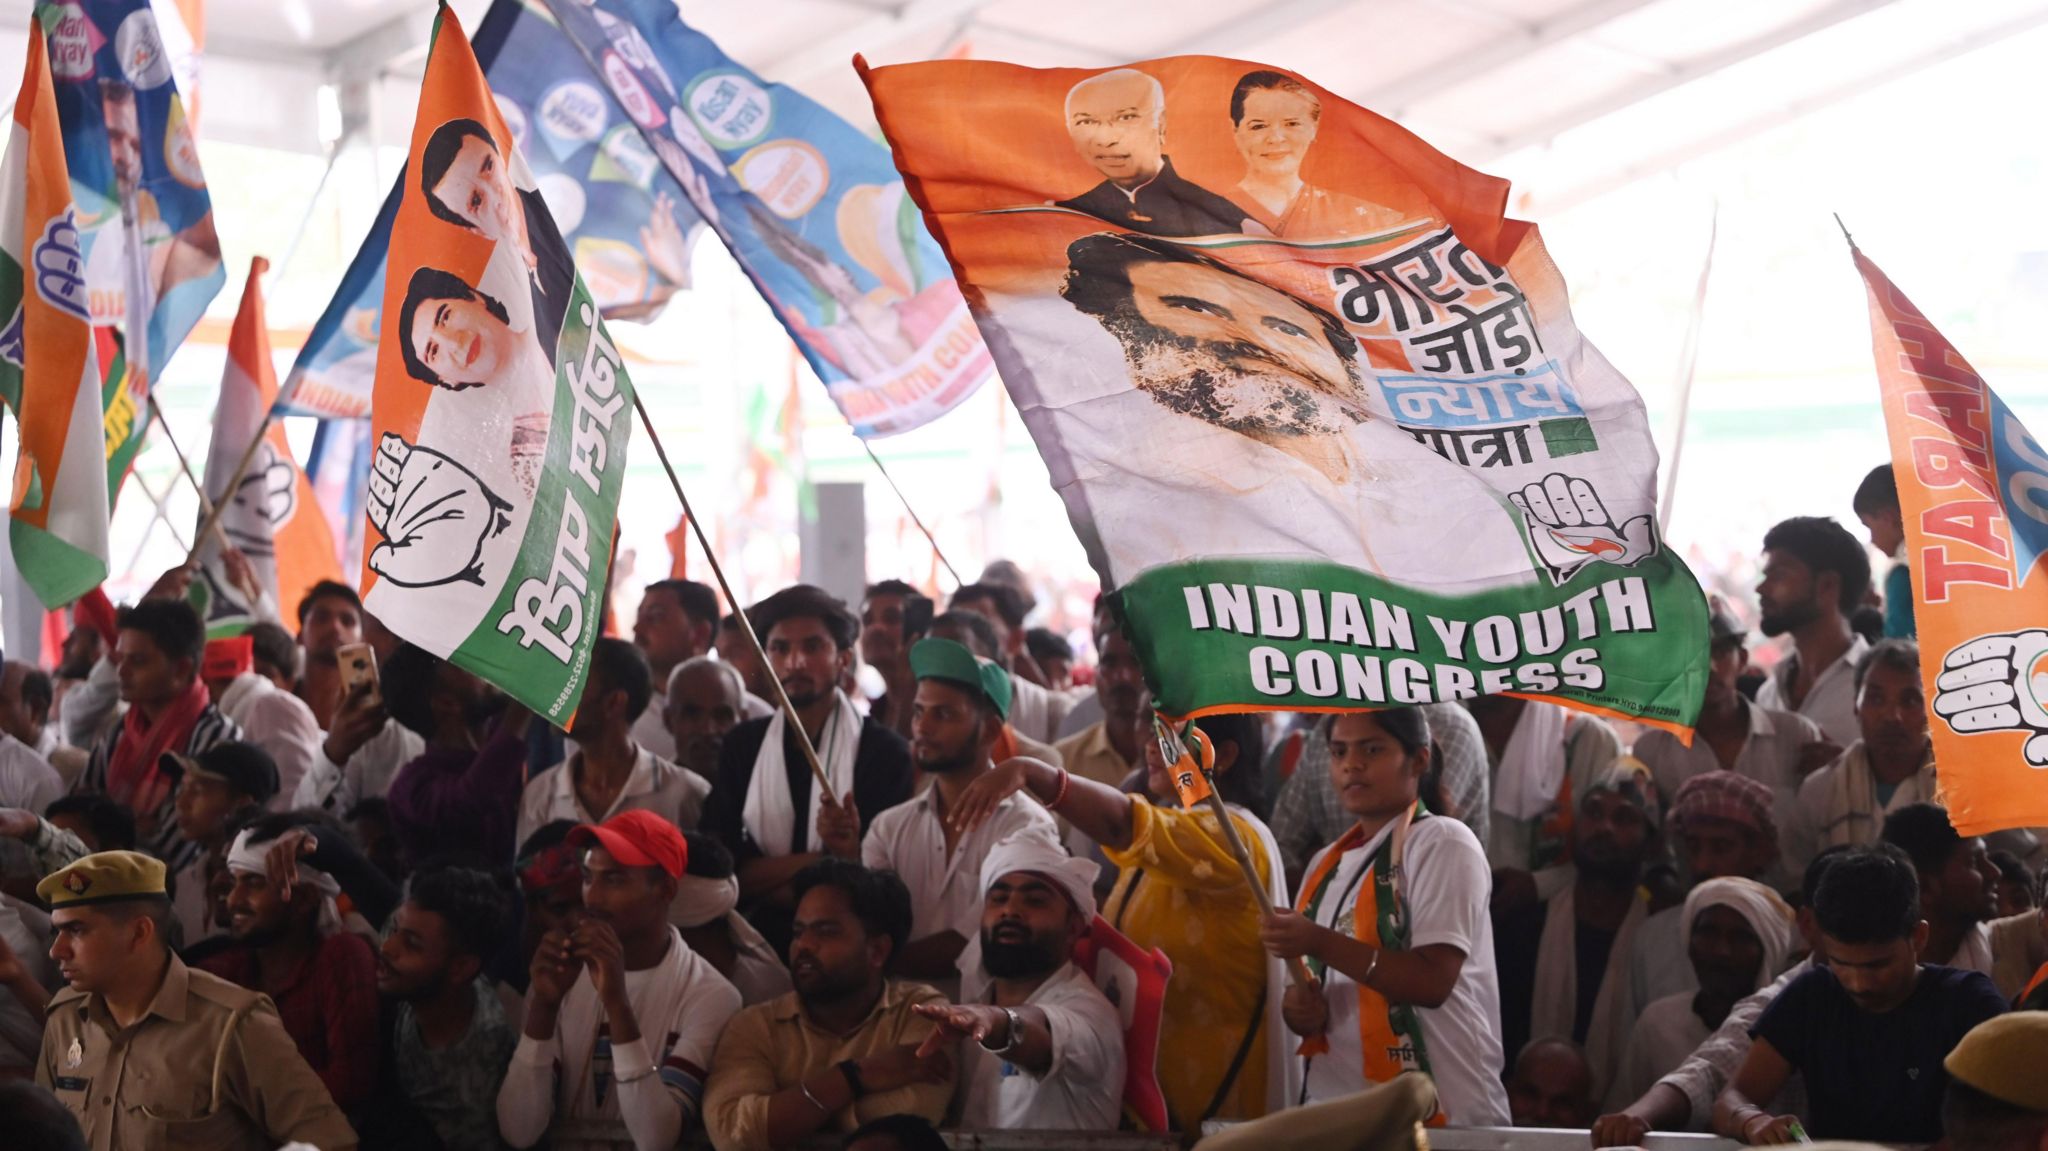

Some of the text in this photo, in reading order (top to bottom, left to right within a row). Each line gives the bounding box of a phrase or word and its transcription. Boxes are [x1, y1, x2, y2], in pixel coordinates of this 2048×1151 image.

[1183, 576, 1656, 664] INDIAN YOUTH
[1249, 646, 1606, 704] CONGRESS
